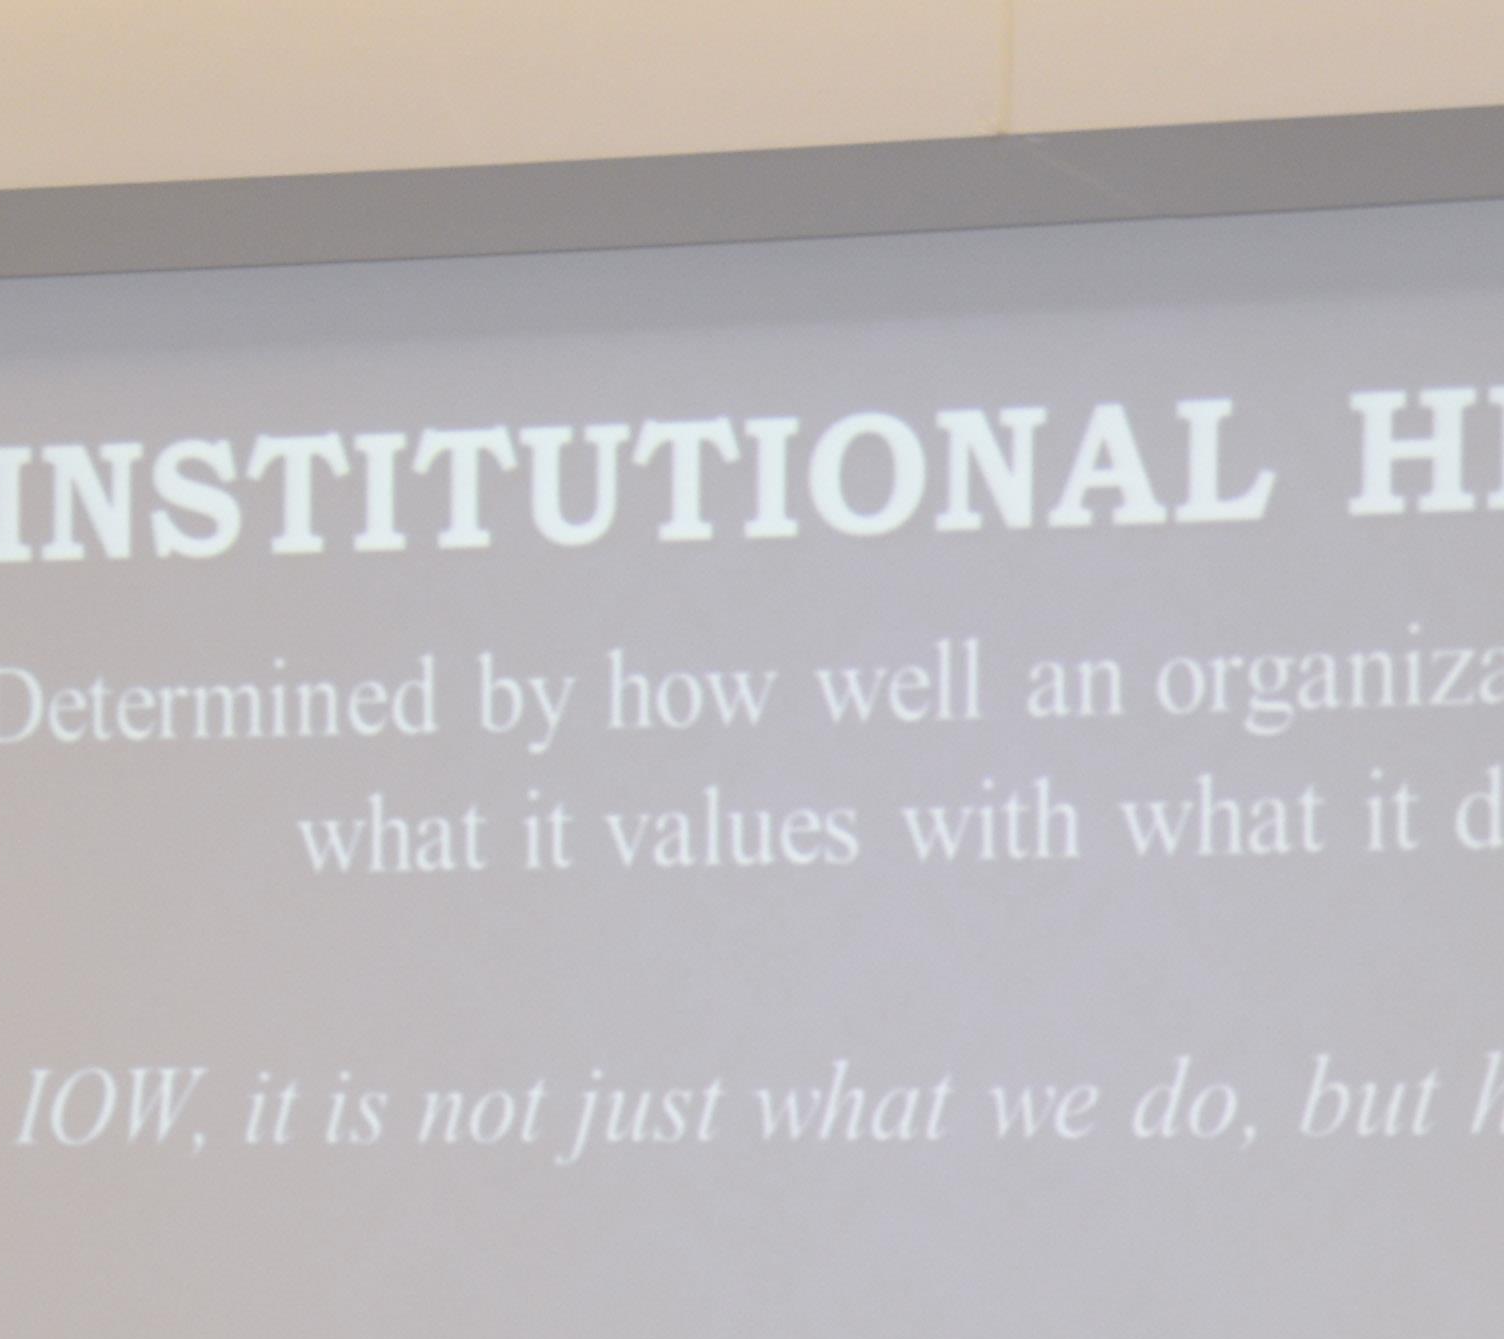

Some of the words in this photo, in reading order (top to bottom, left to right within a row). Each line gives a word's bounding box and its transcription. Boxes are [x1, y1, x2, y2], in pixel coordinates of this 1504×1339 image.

[477, 650, 576, 755] by
[607, 647, 777, 730] how
[815, 636, 982, 723] well
[1026, 658, 1124, 719] an
[297, 791, 486, 873] what
[524, 788, 572, 870] it
[604, 784, 861, 868] values
[901, 775, 1080, 861] with
[1119, 772, 1324, 856] what
[1366, 767, 1418, 852] it
[16, 1066, 207, 1151] IOW,
[244, 1071, 299, 1145] it
[325, 1070, 388, 1145] is
[417, 1079, 547, 1144] not
[555, 1068, 723, 1165] just
[755, 1058, 952, 1142] what
[990, 1084, 1100, 1140] we
[1131, 1054, 1256, 1147] do,
[1299, 1052, 1439, 1137] but
